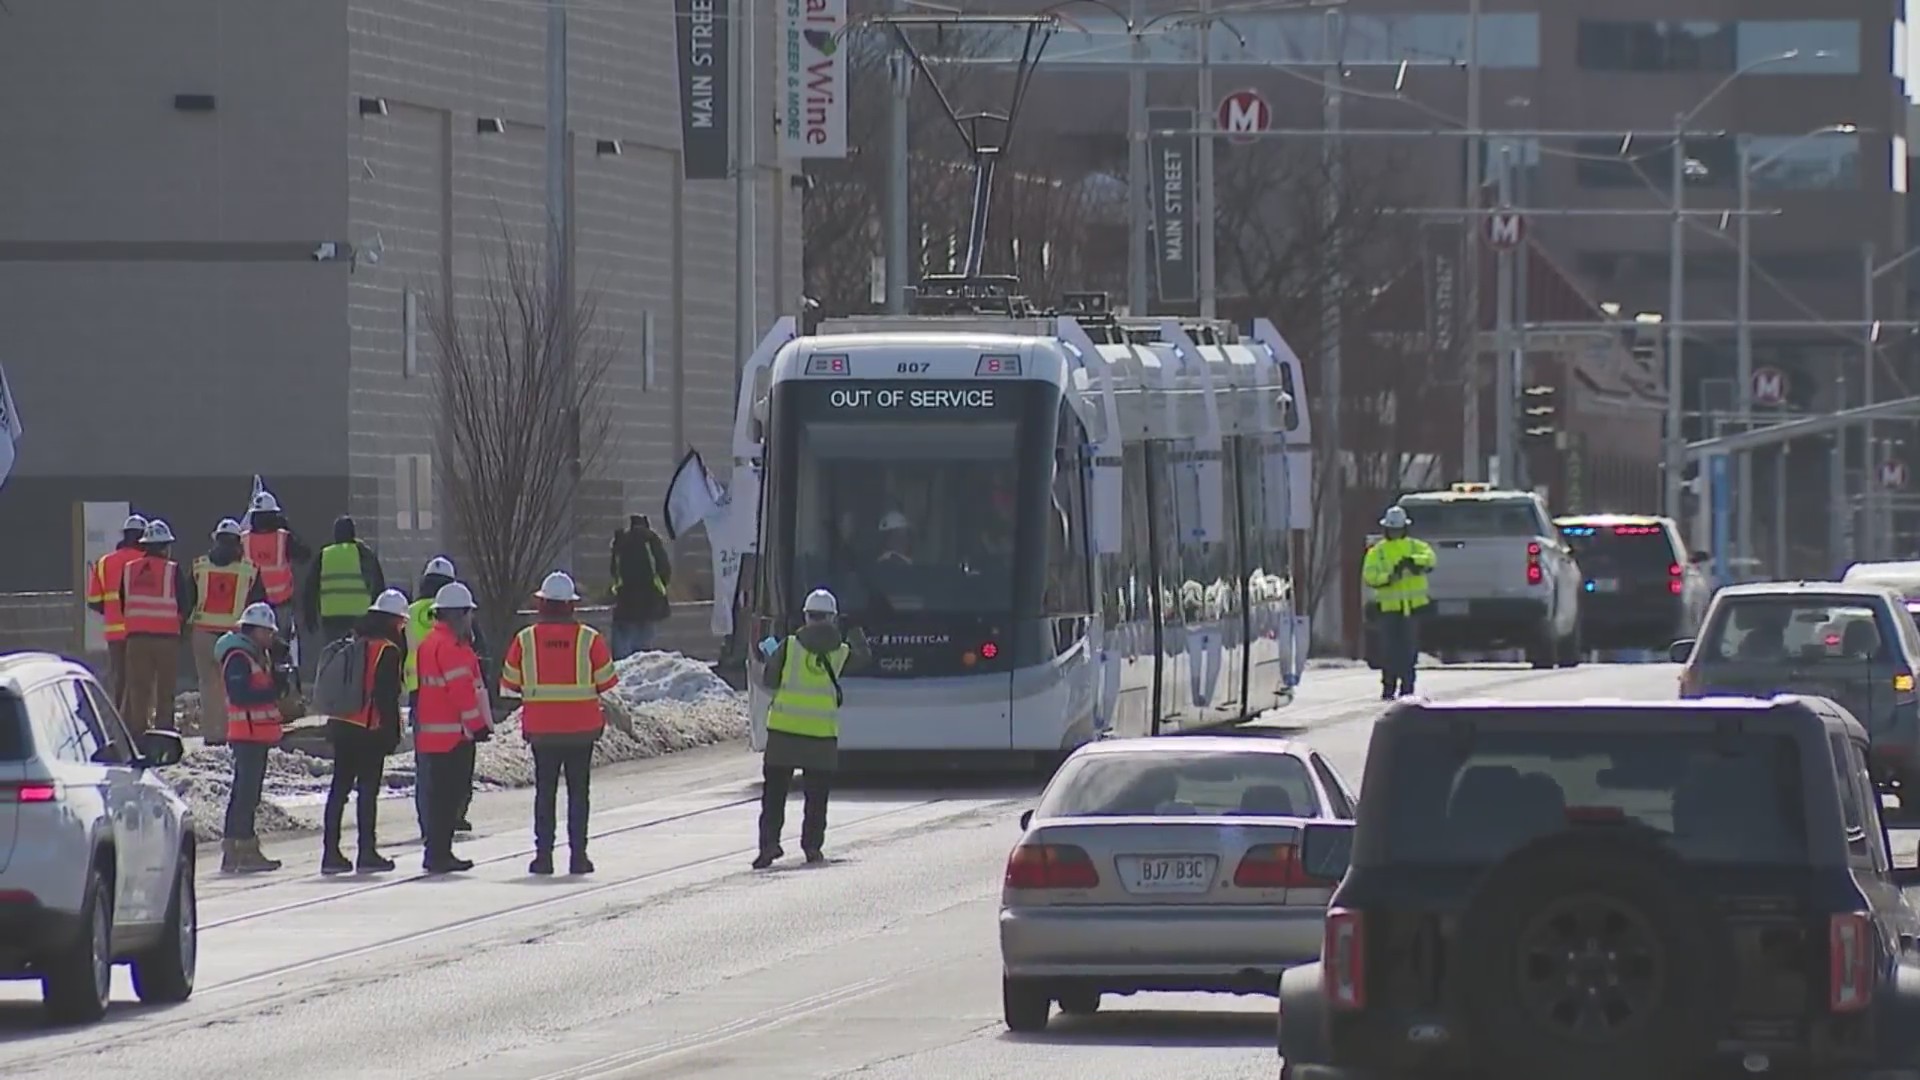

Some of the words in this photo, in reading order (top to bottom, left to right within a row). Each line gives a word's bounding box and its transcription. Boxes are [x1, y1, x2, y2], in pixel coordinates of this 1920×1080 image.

[787, 28, 800, 72] BEER
[787, 77, 800, 88] &
[692, 75, 713, 128] MAIN
[787, 93, 800, 140] MORE
[806, 60, 834, 144] Wine
[1228, 98, 1260, 133] M
[1164, 149, 1183, 214] STREET
[1166, 219, 1183, 261] MAIN
[1492, 214, 1520, 244] M
[897, 362, 931, 373] 807
[830, 390, 872, 408] OUT
[877, 390, 904, 408] OF
[909, 390, 994, 408] SERVICE
[1757, 373, 1782, 399] M
[890, 633, 950, 645] STREETCAR
[1143, 862, 1169, 880] BJ7
